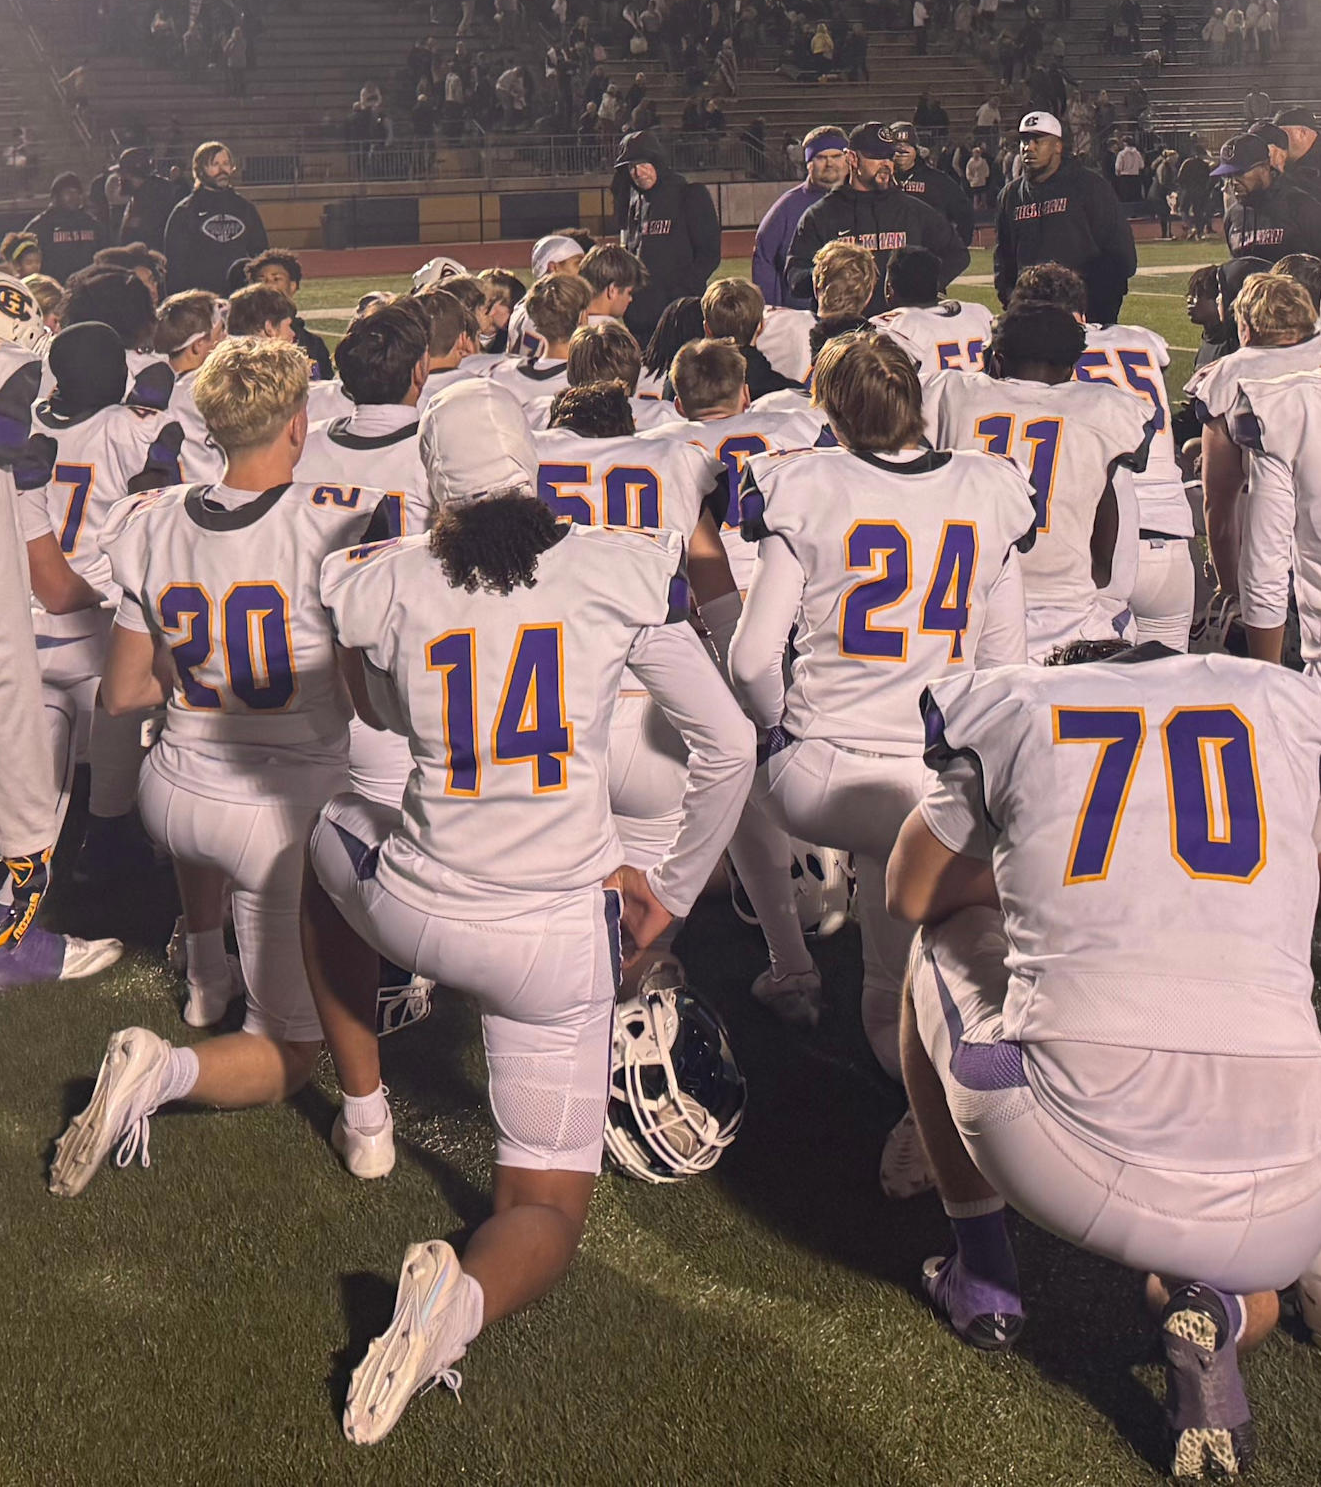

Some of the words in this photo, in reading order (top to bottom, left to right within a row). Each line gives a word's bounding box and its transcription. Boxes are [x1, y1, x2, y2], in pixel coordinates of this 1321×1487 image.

[52, 462, 95, 557] 7
[156, 580, 299, 712] 20
[839, 519, 979, 663] 24
[425, 621, 574, 798] 14
[1051, 703, 1267, 887] 70
